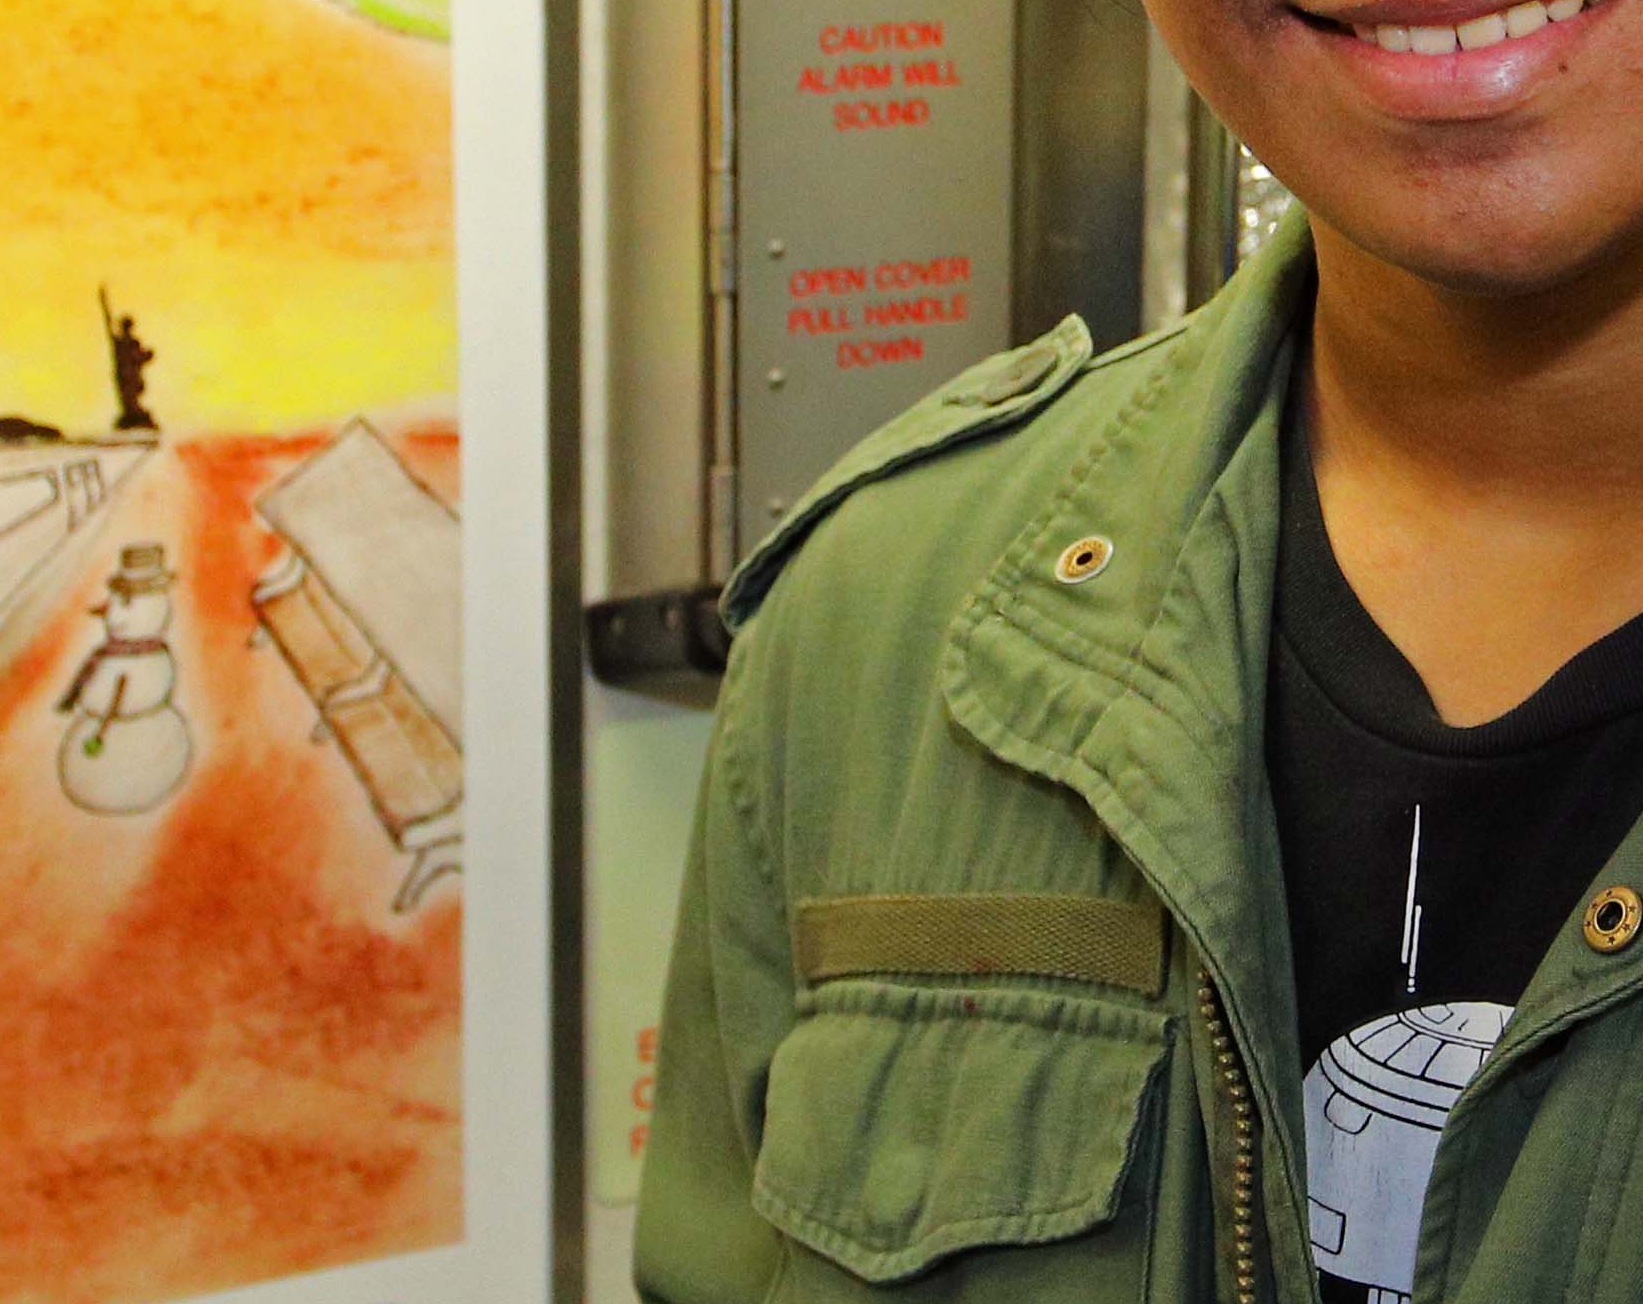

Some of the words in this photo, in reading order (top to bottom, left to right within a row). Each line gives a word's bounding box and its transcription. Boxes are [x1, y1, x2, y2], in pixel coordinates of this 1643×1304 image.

[819, 19, 944, 56] CAUTION
[798, 61, 893, 94] ALARM
[901, 59, 963, 89] WILL
[832, 97, 930, 132] SOUND
[789, 265, 867, 298] OPEN
[873, 255, 971, 291] COVER
[787, 307, 855, 336] PULL
[863, 293, 968, 326] HANDLE
[836, 336, 925, 371] DOWN
